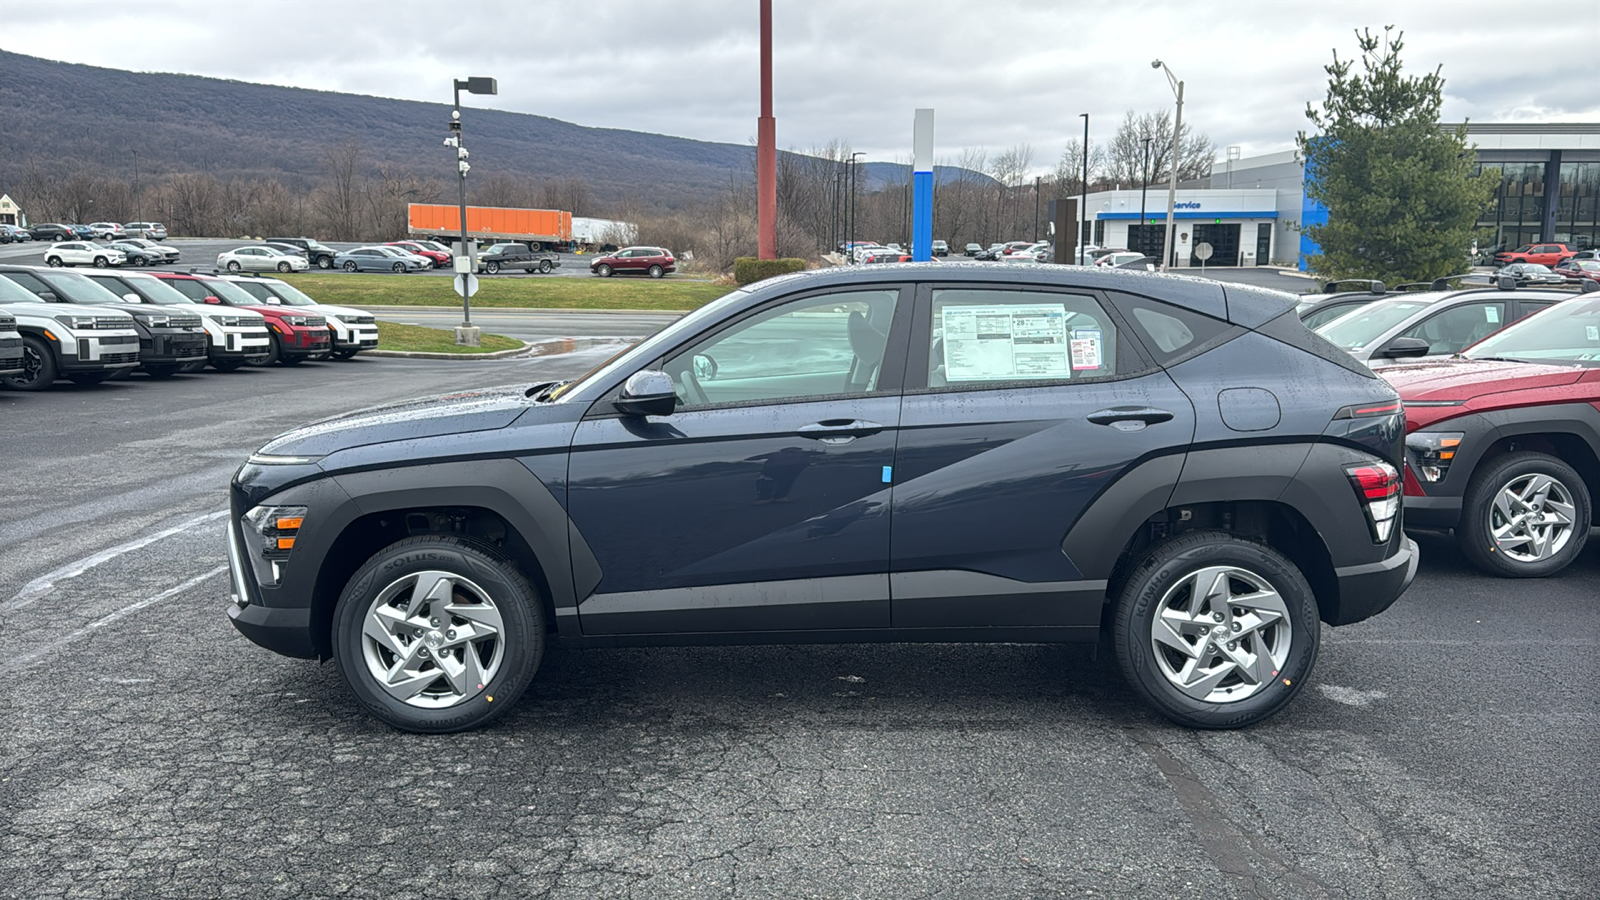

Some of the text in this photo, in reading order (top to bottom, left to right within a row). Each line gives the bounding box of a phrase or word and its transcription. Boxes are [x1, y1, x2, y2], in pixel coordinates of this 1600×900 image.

[1173, 201, 1201, 209] Service
[384, 553, 438, 573] SOLUS
[1136, 569, 1170, 617] KUMHO
[417, 711, 474, 728] KUMHO
